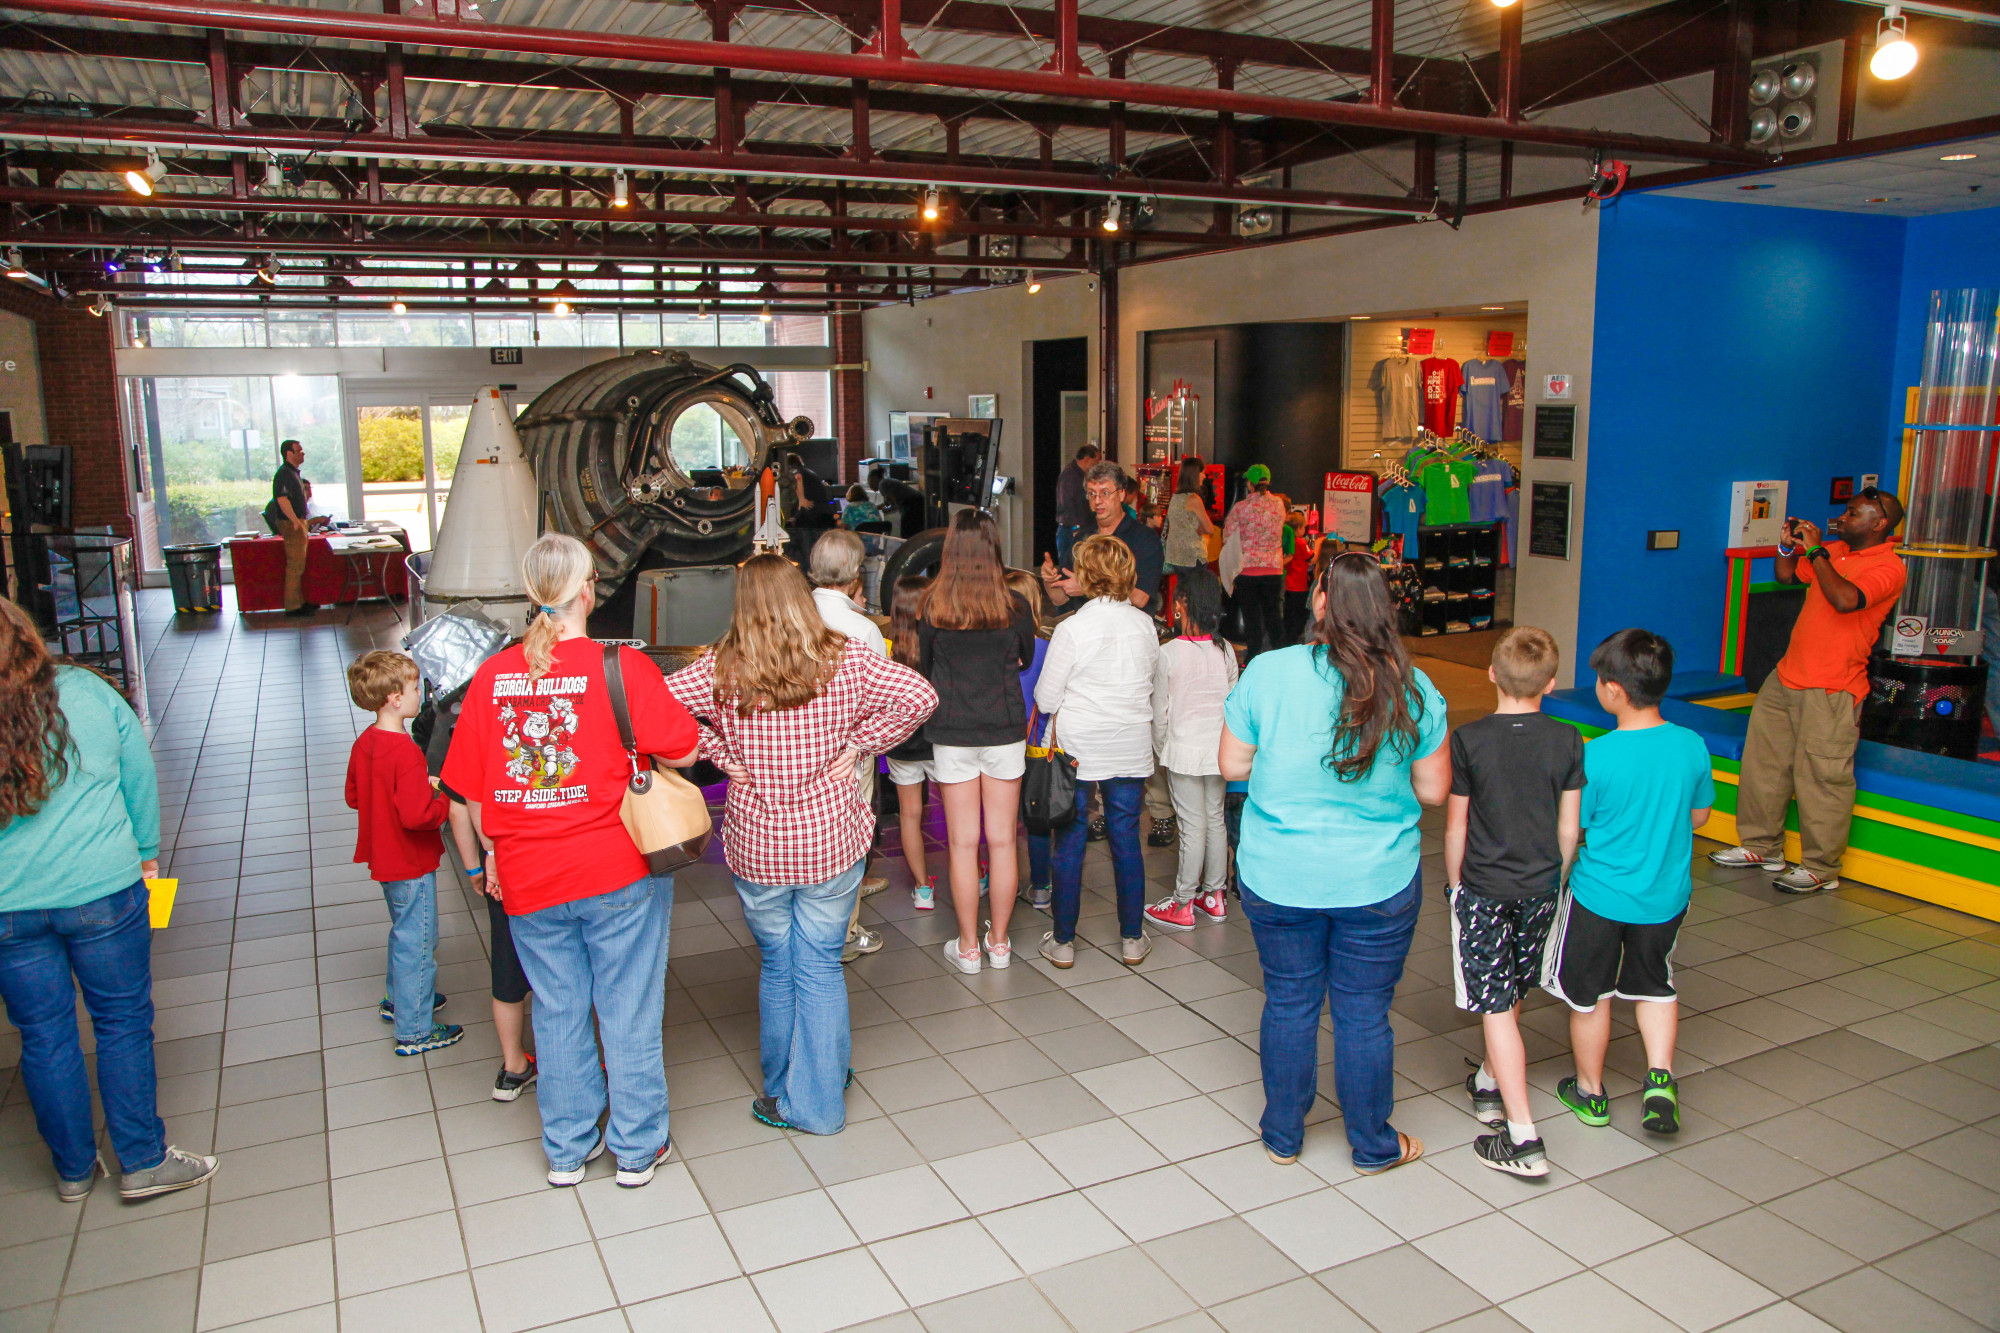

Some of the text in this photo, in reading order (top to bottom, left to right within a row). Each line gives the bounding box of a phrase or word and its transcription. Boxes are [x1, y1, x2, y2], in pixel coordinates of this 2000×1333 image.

[494, 349, 518, 363] EXIT
[1928, 629, 1961, 637] LAUNCH
[493, 676, 588, 697] GEORGIA BULLDOGS
[499, 696, 535, 707] ALABAMA
[494, 784, 588, 803] STEP ASIDE, TIDE!
